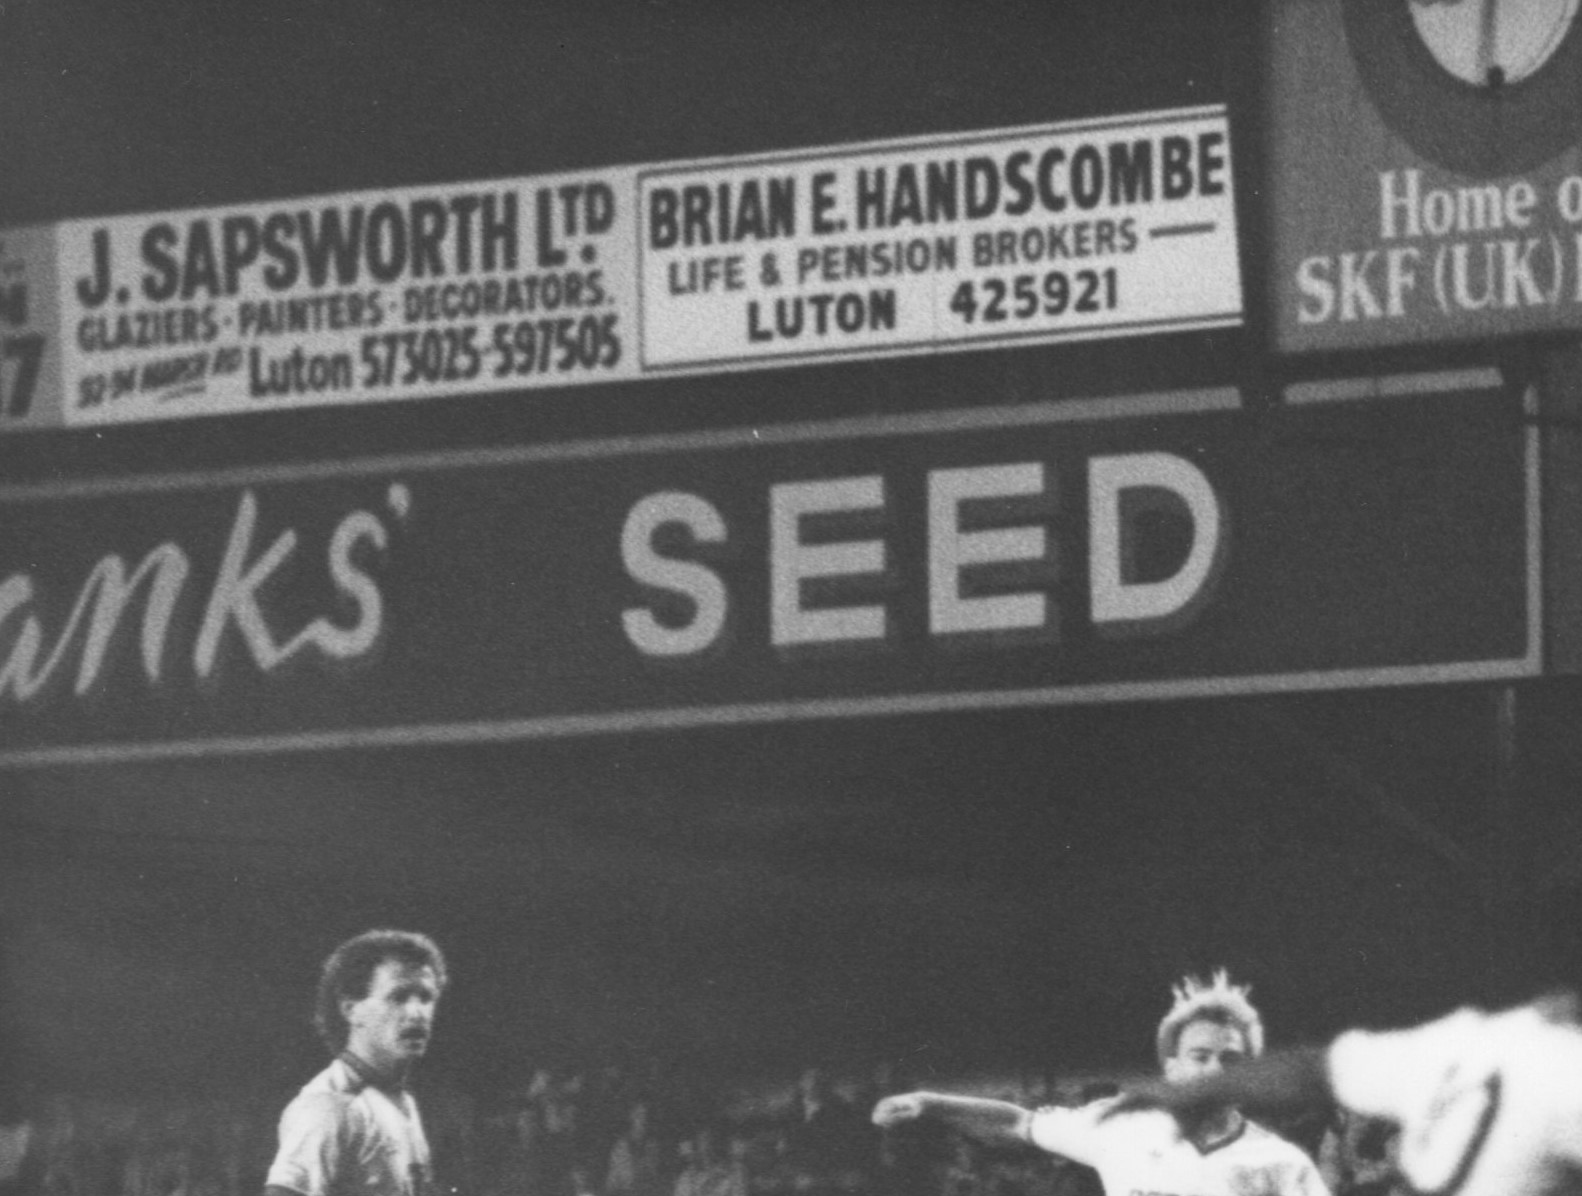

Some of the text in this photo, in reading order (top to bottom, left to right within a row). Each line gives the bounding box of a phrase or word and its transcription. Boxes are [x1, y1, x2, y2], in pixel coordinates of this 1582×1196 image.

[650, 176, 797, 251] BRIAN
[856, 131, 1226, 231] HANDSCOMBE
[1379, 167, 1539, 239] Home
[76, 227, 131, 308] J.
[140, 193, 518, 302] SAPSWORTH
[667, 217, 1139, 296] LIFE & PENSION BROKERS
[77, 307, 219, 353] GLAZIERS
[239, 291, 385, 336] PAINTERS
[747, 266, 1119, 343] LUTON 425921
[248, 345, 354, 398] Luton
[619, 450, 1222, 657] SEED
